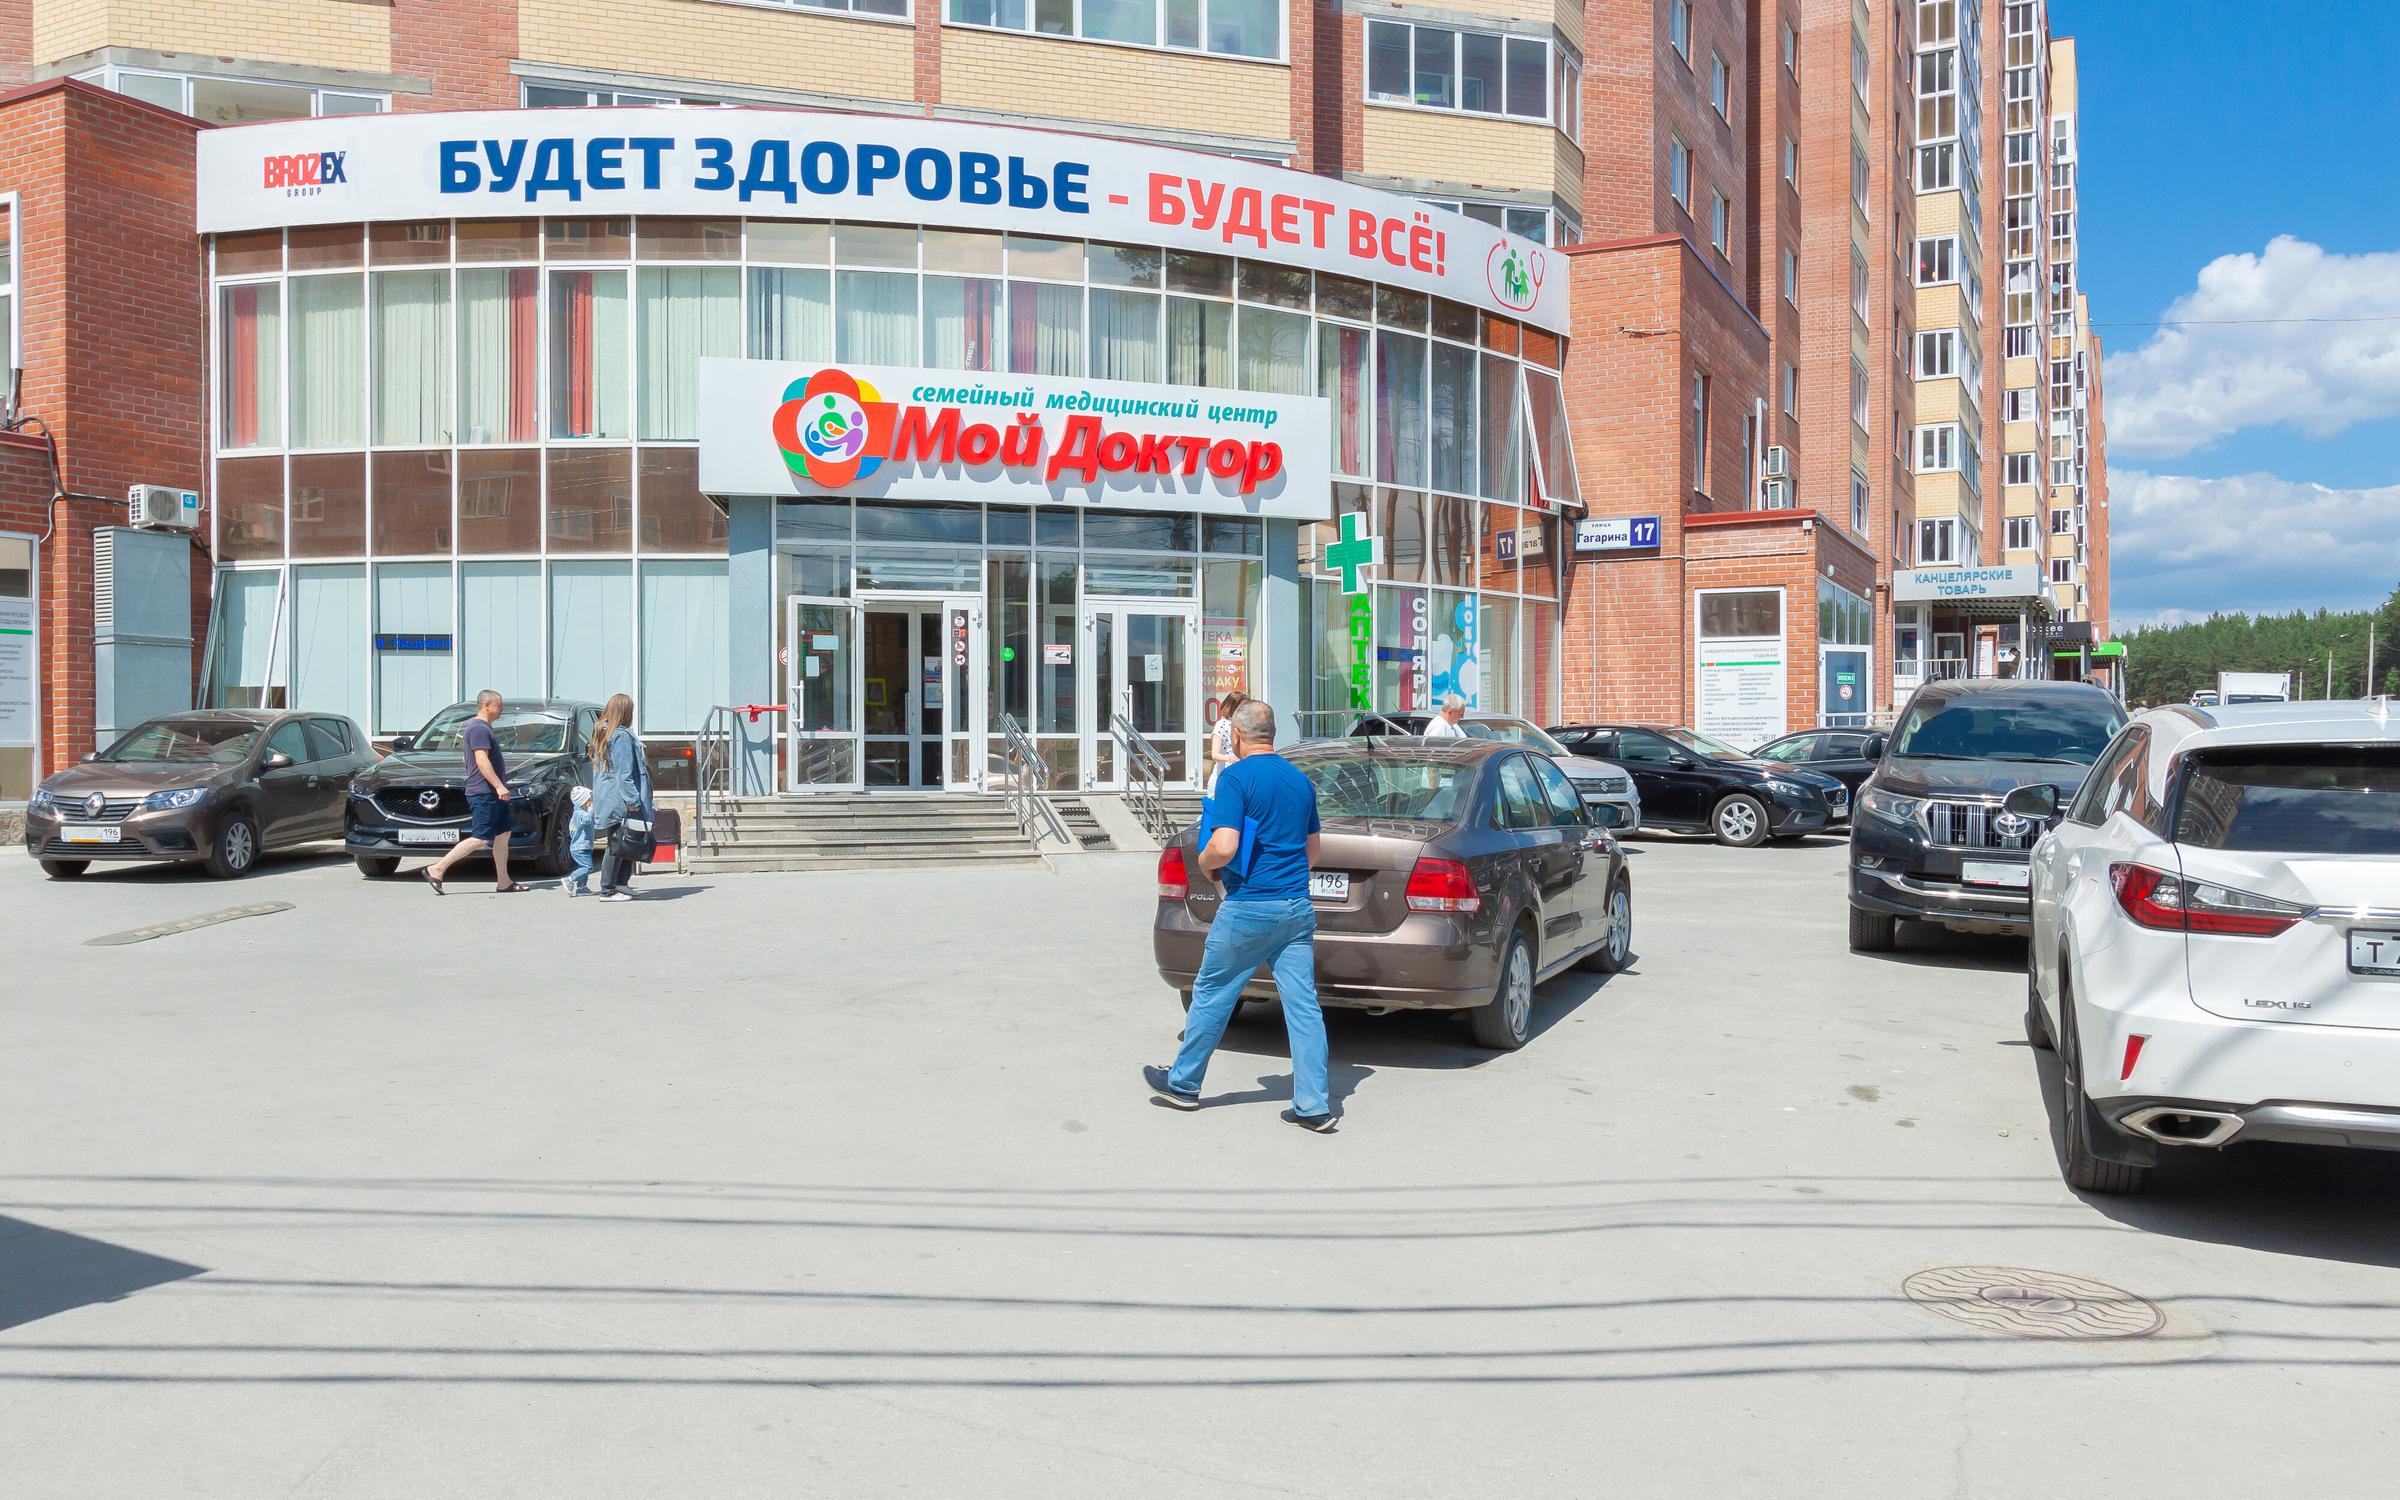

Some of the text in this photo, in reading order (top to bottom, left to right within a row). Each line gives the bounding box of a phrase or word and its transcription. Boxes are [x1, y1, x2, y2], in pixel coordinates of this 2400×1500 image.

[264, 151, 347, 189] BROZEX
[286, 187, 322, 198] GROUP
[440, 137, 675, 202] БУДЕТ
[694, 138, 1089, 213] ЗДОРОВЬЕ
[1149, 172, 1334, 248] БУДЕТ
[1349, 209, 1446, 276] ВСЁ!
[912, 384, 1279, 427] семейный медицинский центр
[892, 407, 1284, 494] Мой Доктор
[1577, 533, 1628, 544] Гагарина
[1634, 523, 1655, 542] 17
[1915, 570, 2012, 584] КАНЦЕЛЯРСКИЕ
[1350, 593, 1371, 717] АПТЕК
[103, 828, 119, 836] 196
[441, 831, 457, 839] 196
[1317, 873, 1343, 889] 196
[1189, 893, 1215, 901] POLO
[2245, 999, 2312, 1009] LEXUS
